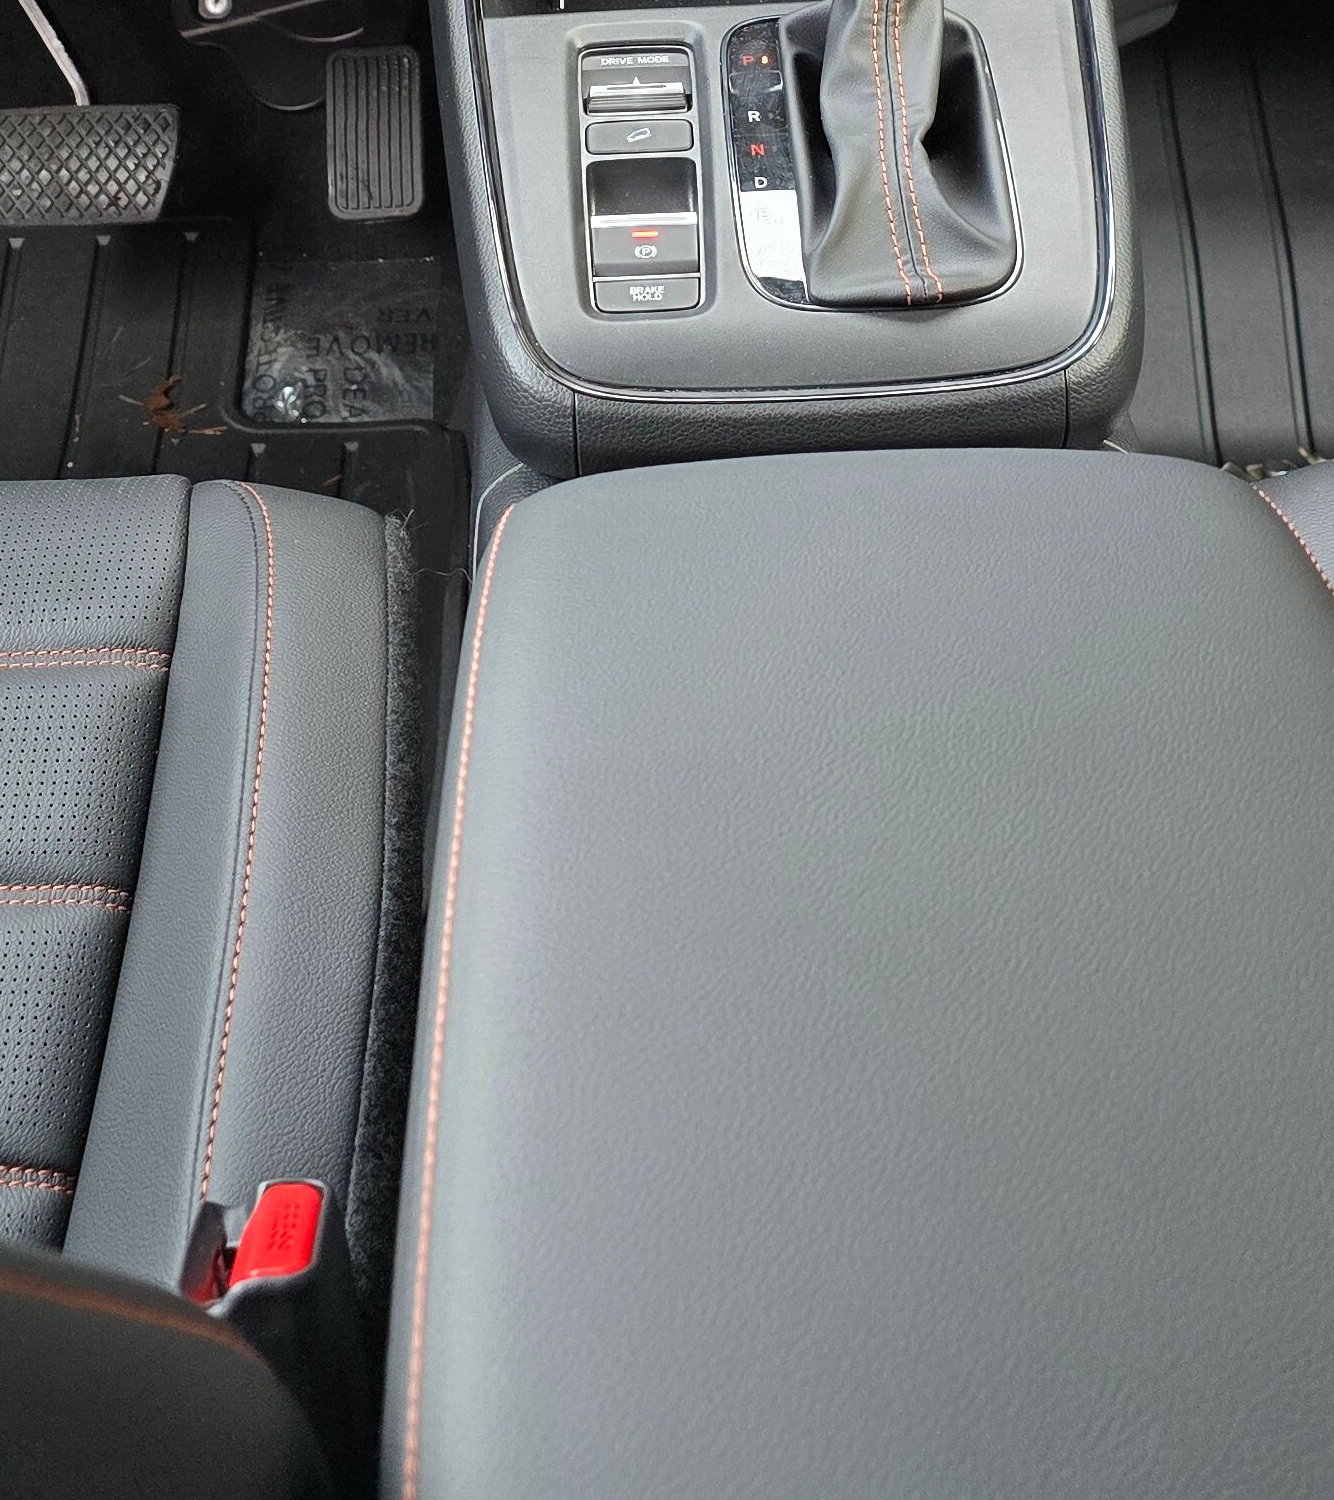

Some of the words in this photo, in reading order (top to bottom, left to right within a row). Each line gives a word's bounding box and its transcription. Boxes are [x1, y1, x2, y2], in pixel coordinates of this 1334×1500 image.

[600, 57, 634, 66] DRIVE
[637, 55, 670, 64] MODE
[742, 56, 755, 65] P
[747, 110, 762, 123] R
[750, 143, 766, 157] N
[754, 176, 768, 189] D
[629, 285, 665, 295] BRAKE
[632, 292, 663, 302] HOLD
